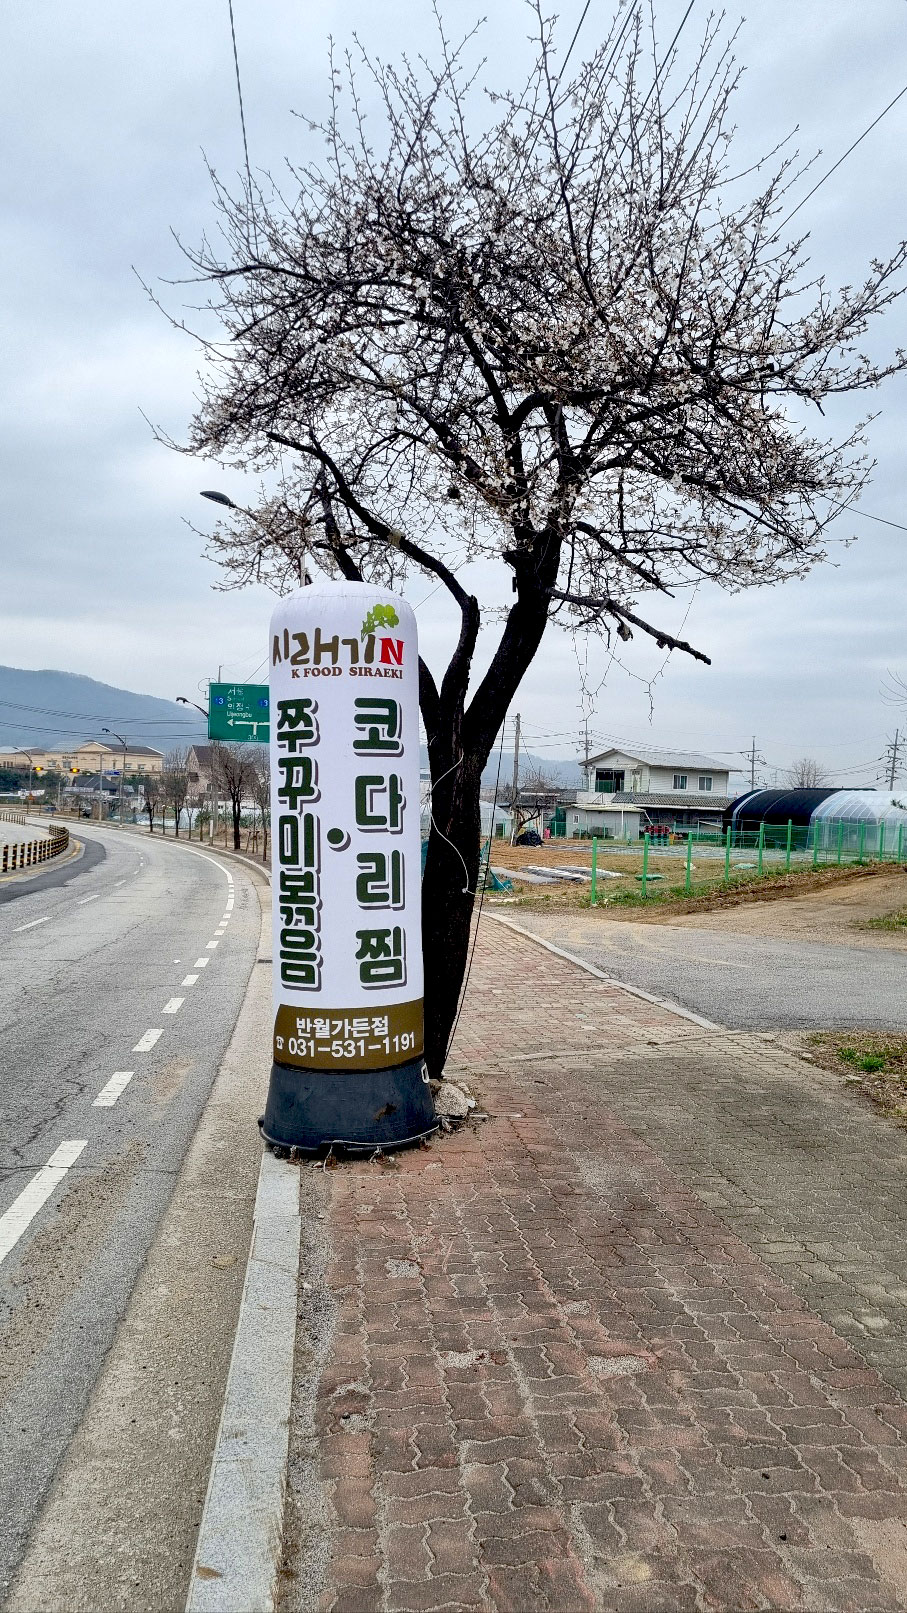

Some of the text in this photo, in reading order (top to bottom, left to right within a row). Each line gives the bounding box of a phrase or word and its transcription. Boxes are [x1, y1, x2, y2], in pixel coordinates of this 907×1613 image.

[291, 666, 403, 679] K FOOD SIRAEKI
[277, 698, 322, 992] 쭈꾸미볶음
[353, 698, 407, 991] 코다리찜
[296, 1016, 389, 1039] 반월가든점
[288, 1031, 415, 1058] 031-531-1191
